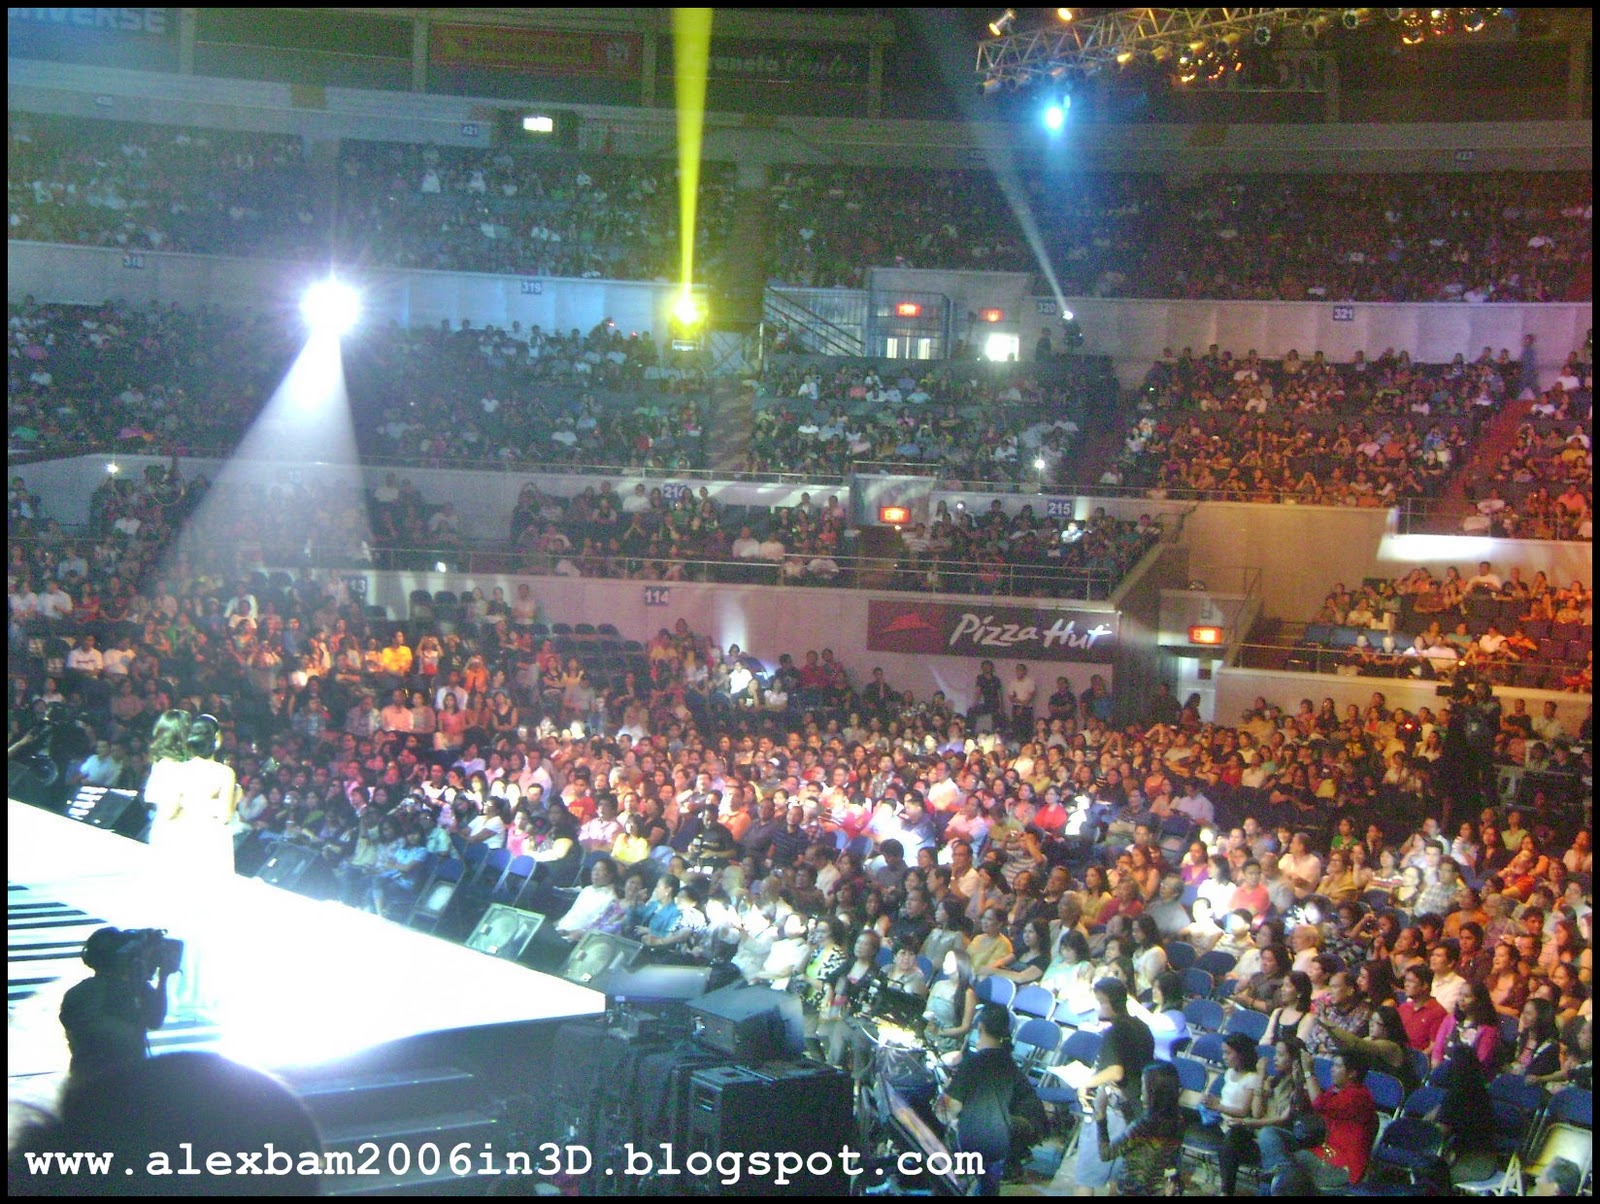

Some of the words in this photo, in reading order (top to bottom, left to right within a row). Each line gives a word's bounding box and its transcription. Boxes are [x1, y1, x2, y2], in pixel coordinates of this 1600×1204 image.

[1048, 502, 1071, 515] 215
[645, 589, 669, 604] 114
[950, 613, 1039, 648] Pizza
[1039, 619, 1112, 650] Hut
